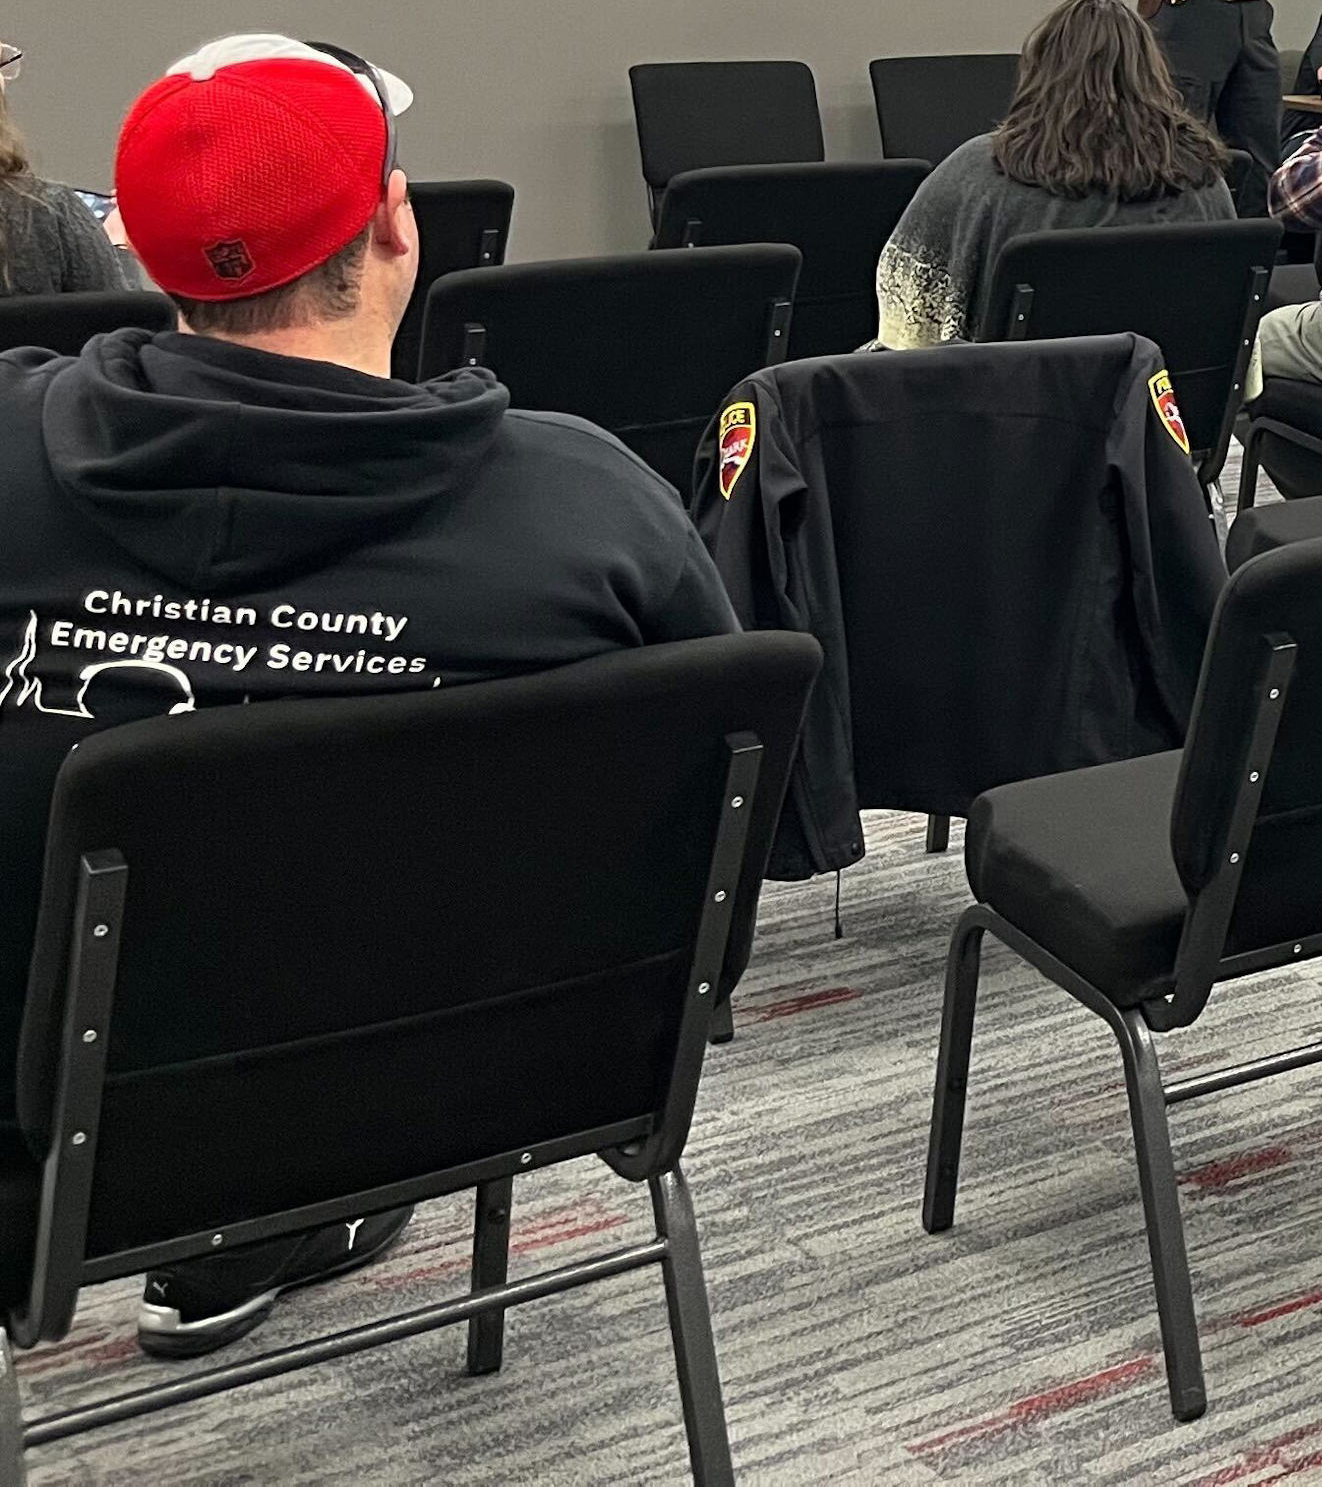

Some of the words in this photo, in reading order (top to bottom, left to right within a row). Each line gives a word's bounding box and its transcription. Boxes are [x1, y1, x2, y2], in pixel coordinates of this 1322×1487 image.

[84, 590, 257, 625] Christian
[270, 604, 408, 641] County
[50, 620, 258, 672] Emergency
[266, 643, 427, 674] Services
